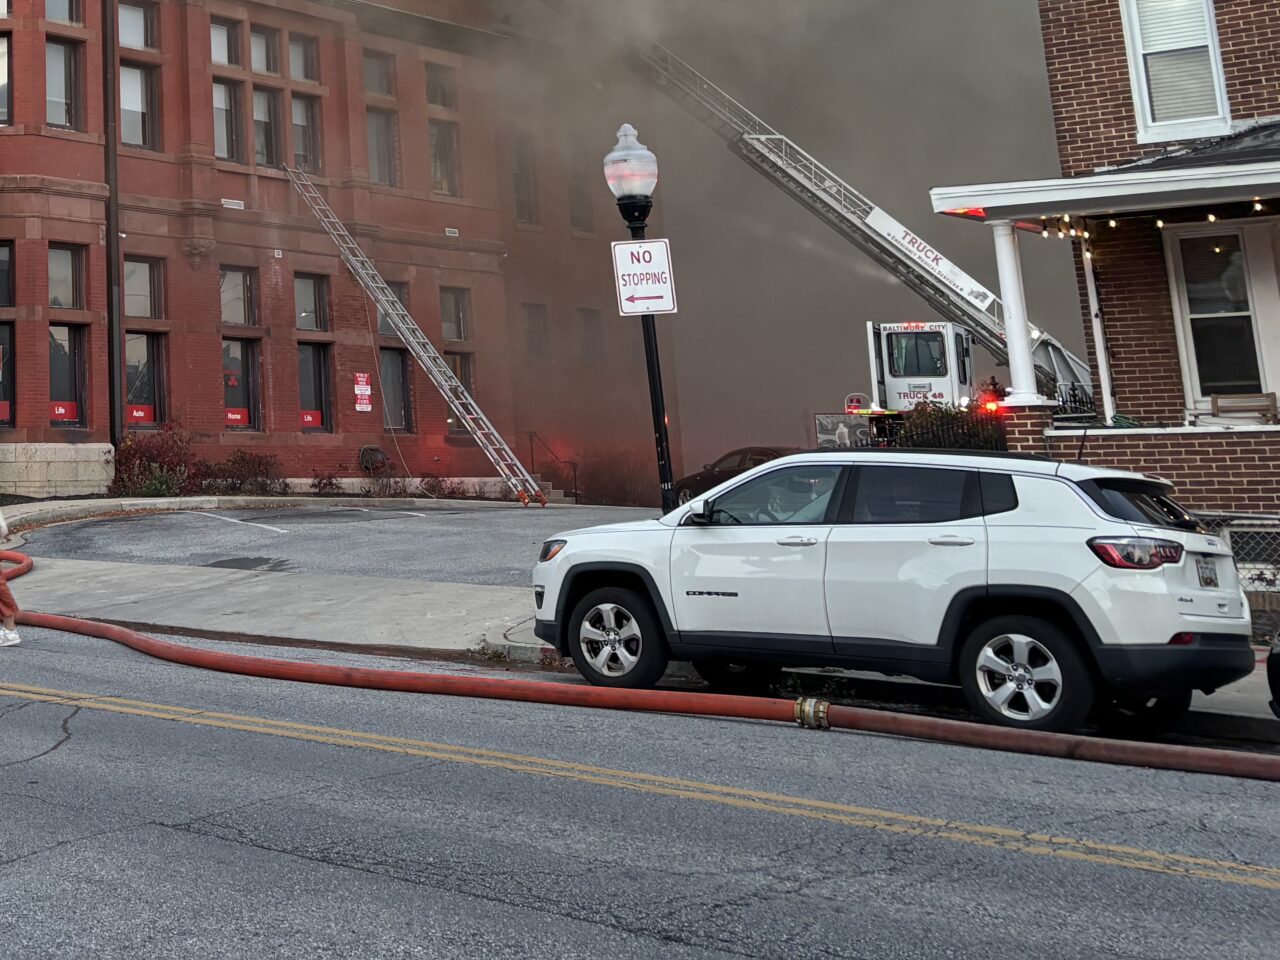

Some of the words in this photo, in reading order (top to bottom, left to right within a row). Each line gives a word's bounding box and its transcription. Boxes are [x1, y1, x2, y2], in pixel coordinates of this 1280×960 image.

[900, 229, 944, 267] TRUCK
[630, 250, 652, 264] NO
[621, 271, 668, 287] STOPPING
[882, 324, 926, 332] BALTIMORE
[929, 323, 946, 331] CITY
[896, 392, 929, 400] TRUCK
[55, 406, 65, 414] Life
[132, 409, 145, 418] Auto
[227, 412, 241, 420] Home
[304, 414, 313, 422] Life
